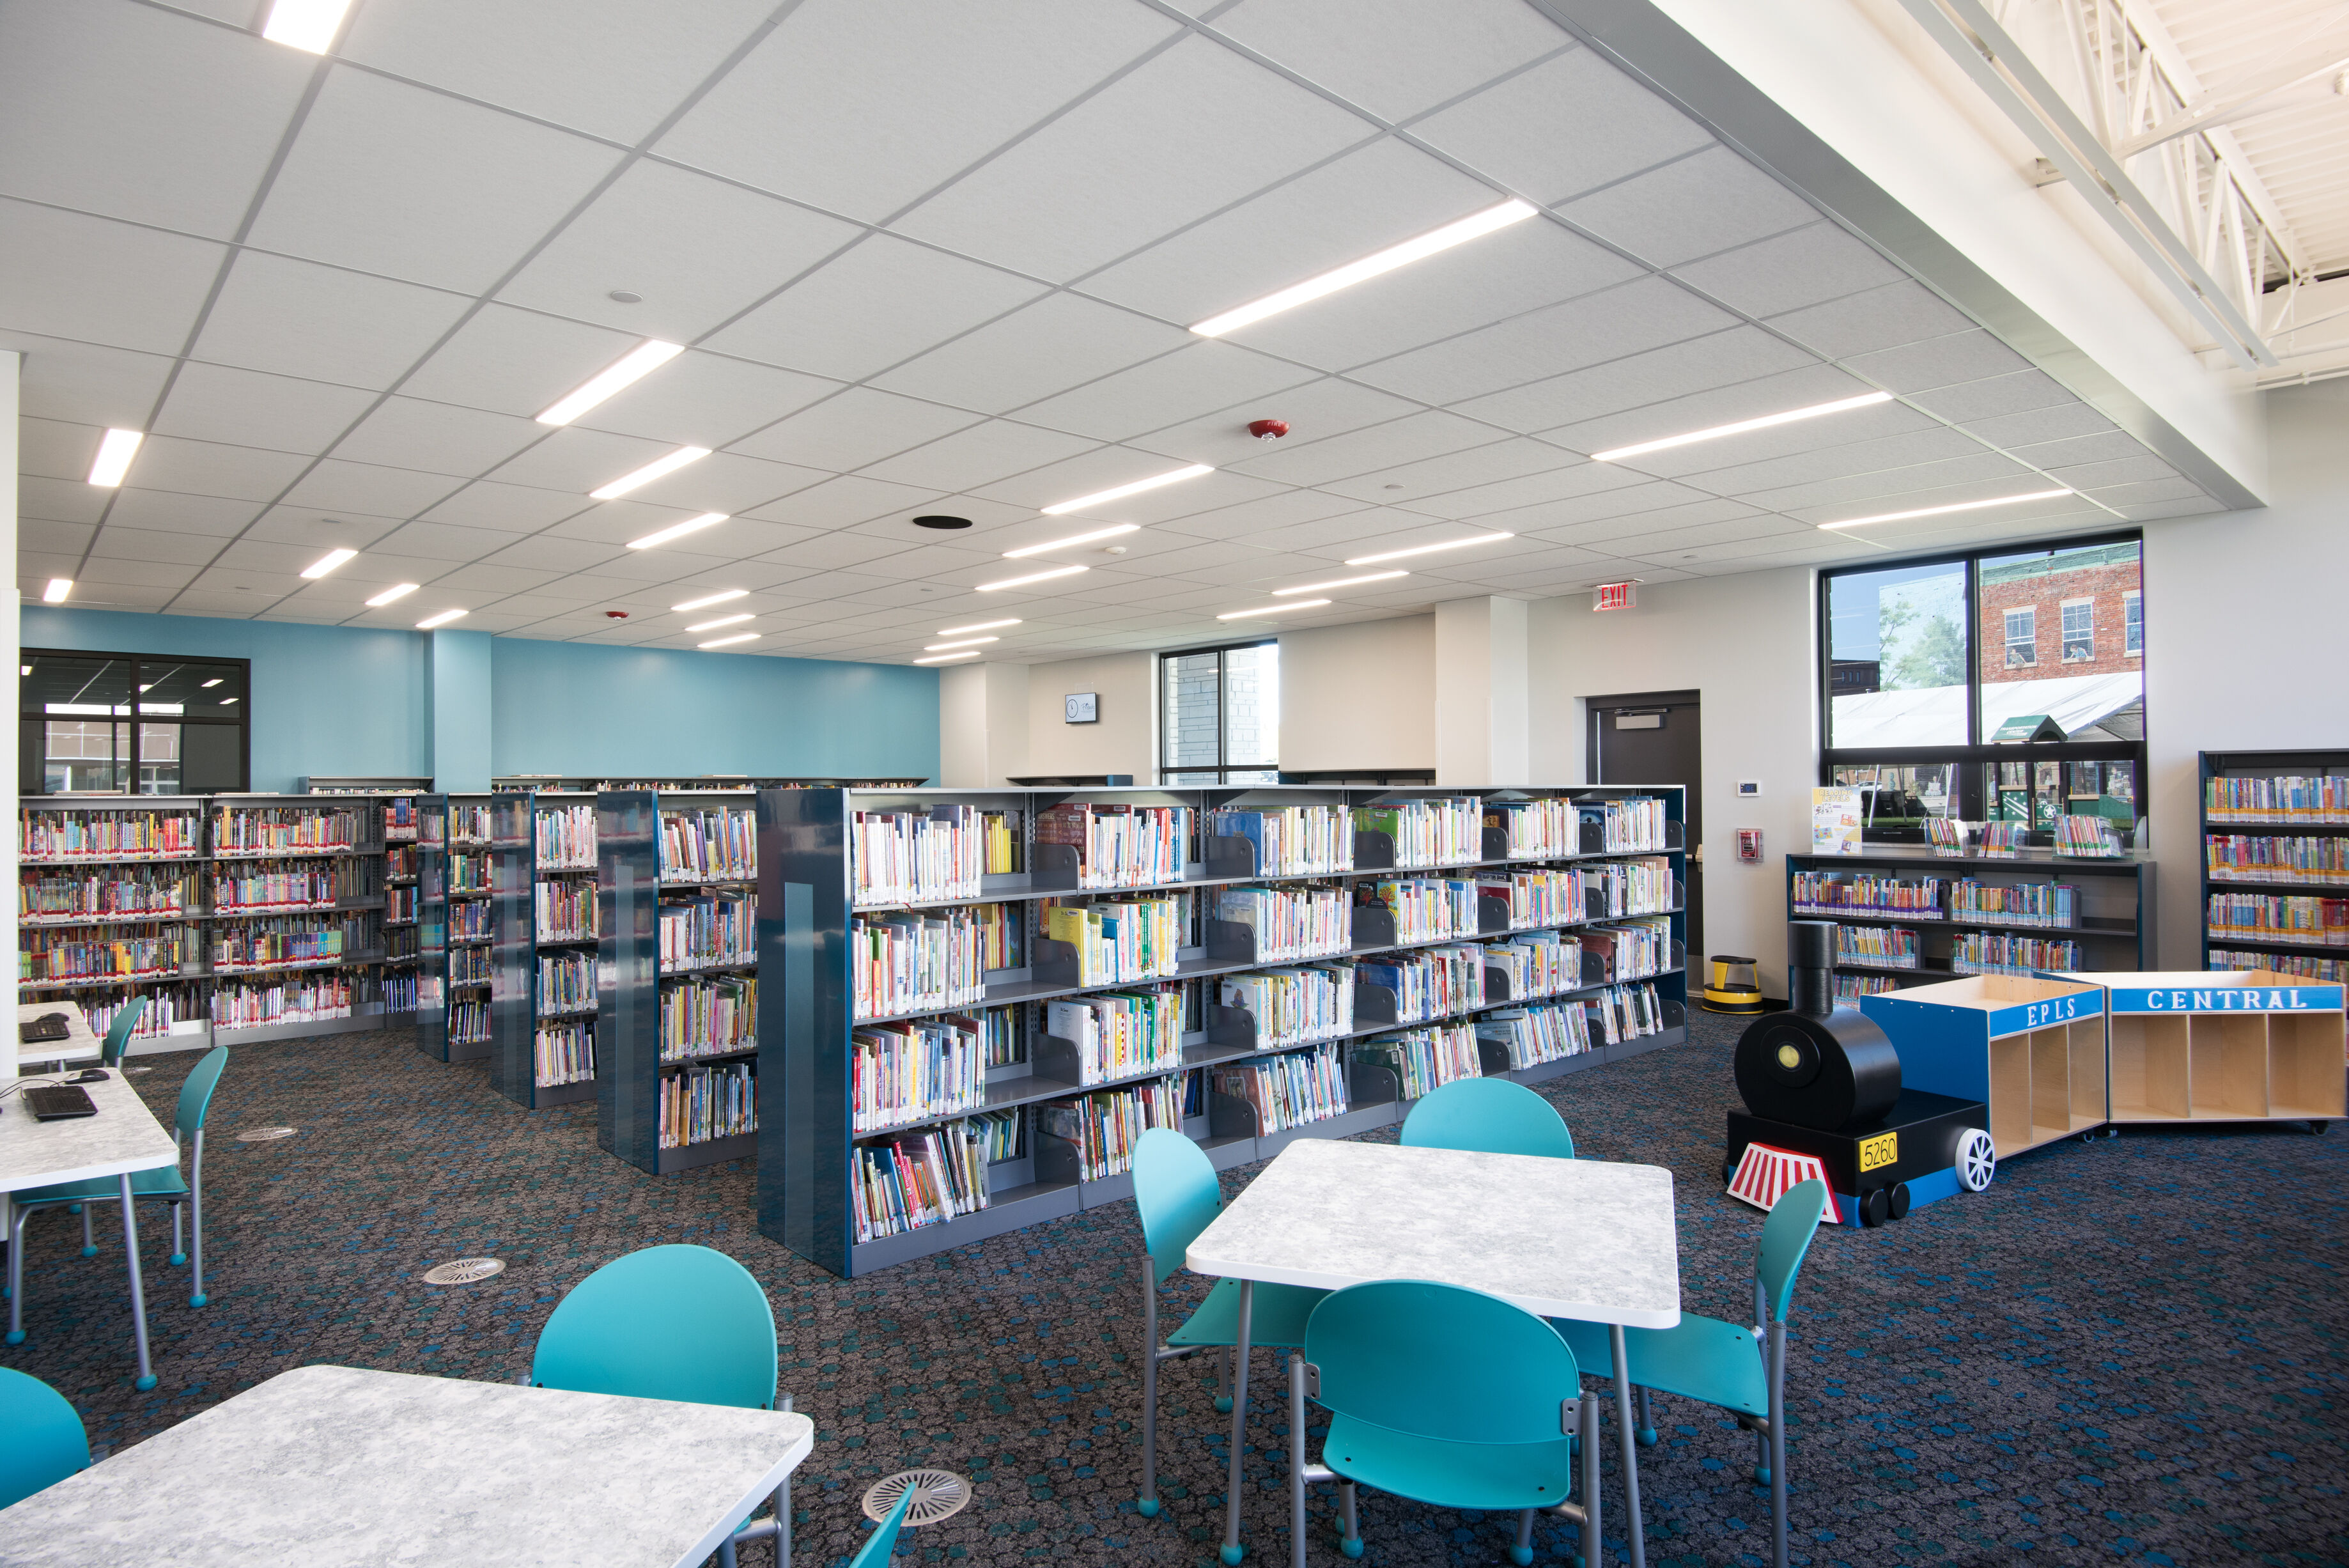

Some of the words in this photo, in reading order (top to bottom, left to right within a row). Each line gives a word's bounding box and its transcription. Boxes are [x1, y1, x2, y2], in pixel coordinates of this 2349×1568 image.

[1602, 584, 1628, 608] EXIT
[2027, 998, 2075, 1027] EPLS
[2148, 990, 2307, 1009] CENTRAL
[1864, 1138, 1896, 1167] 5260
